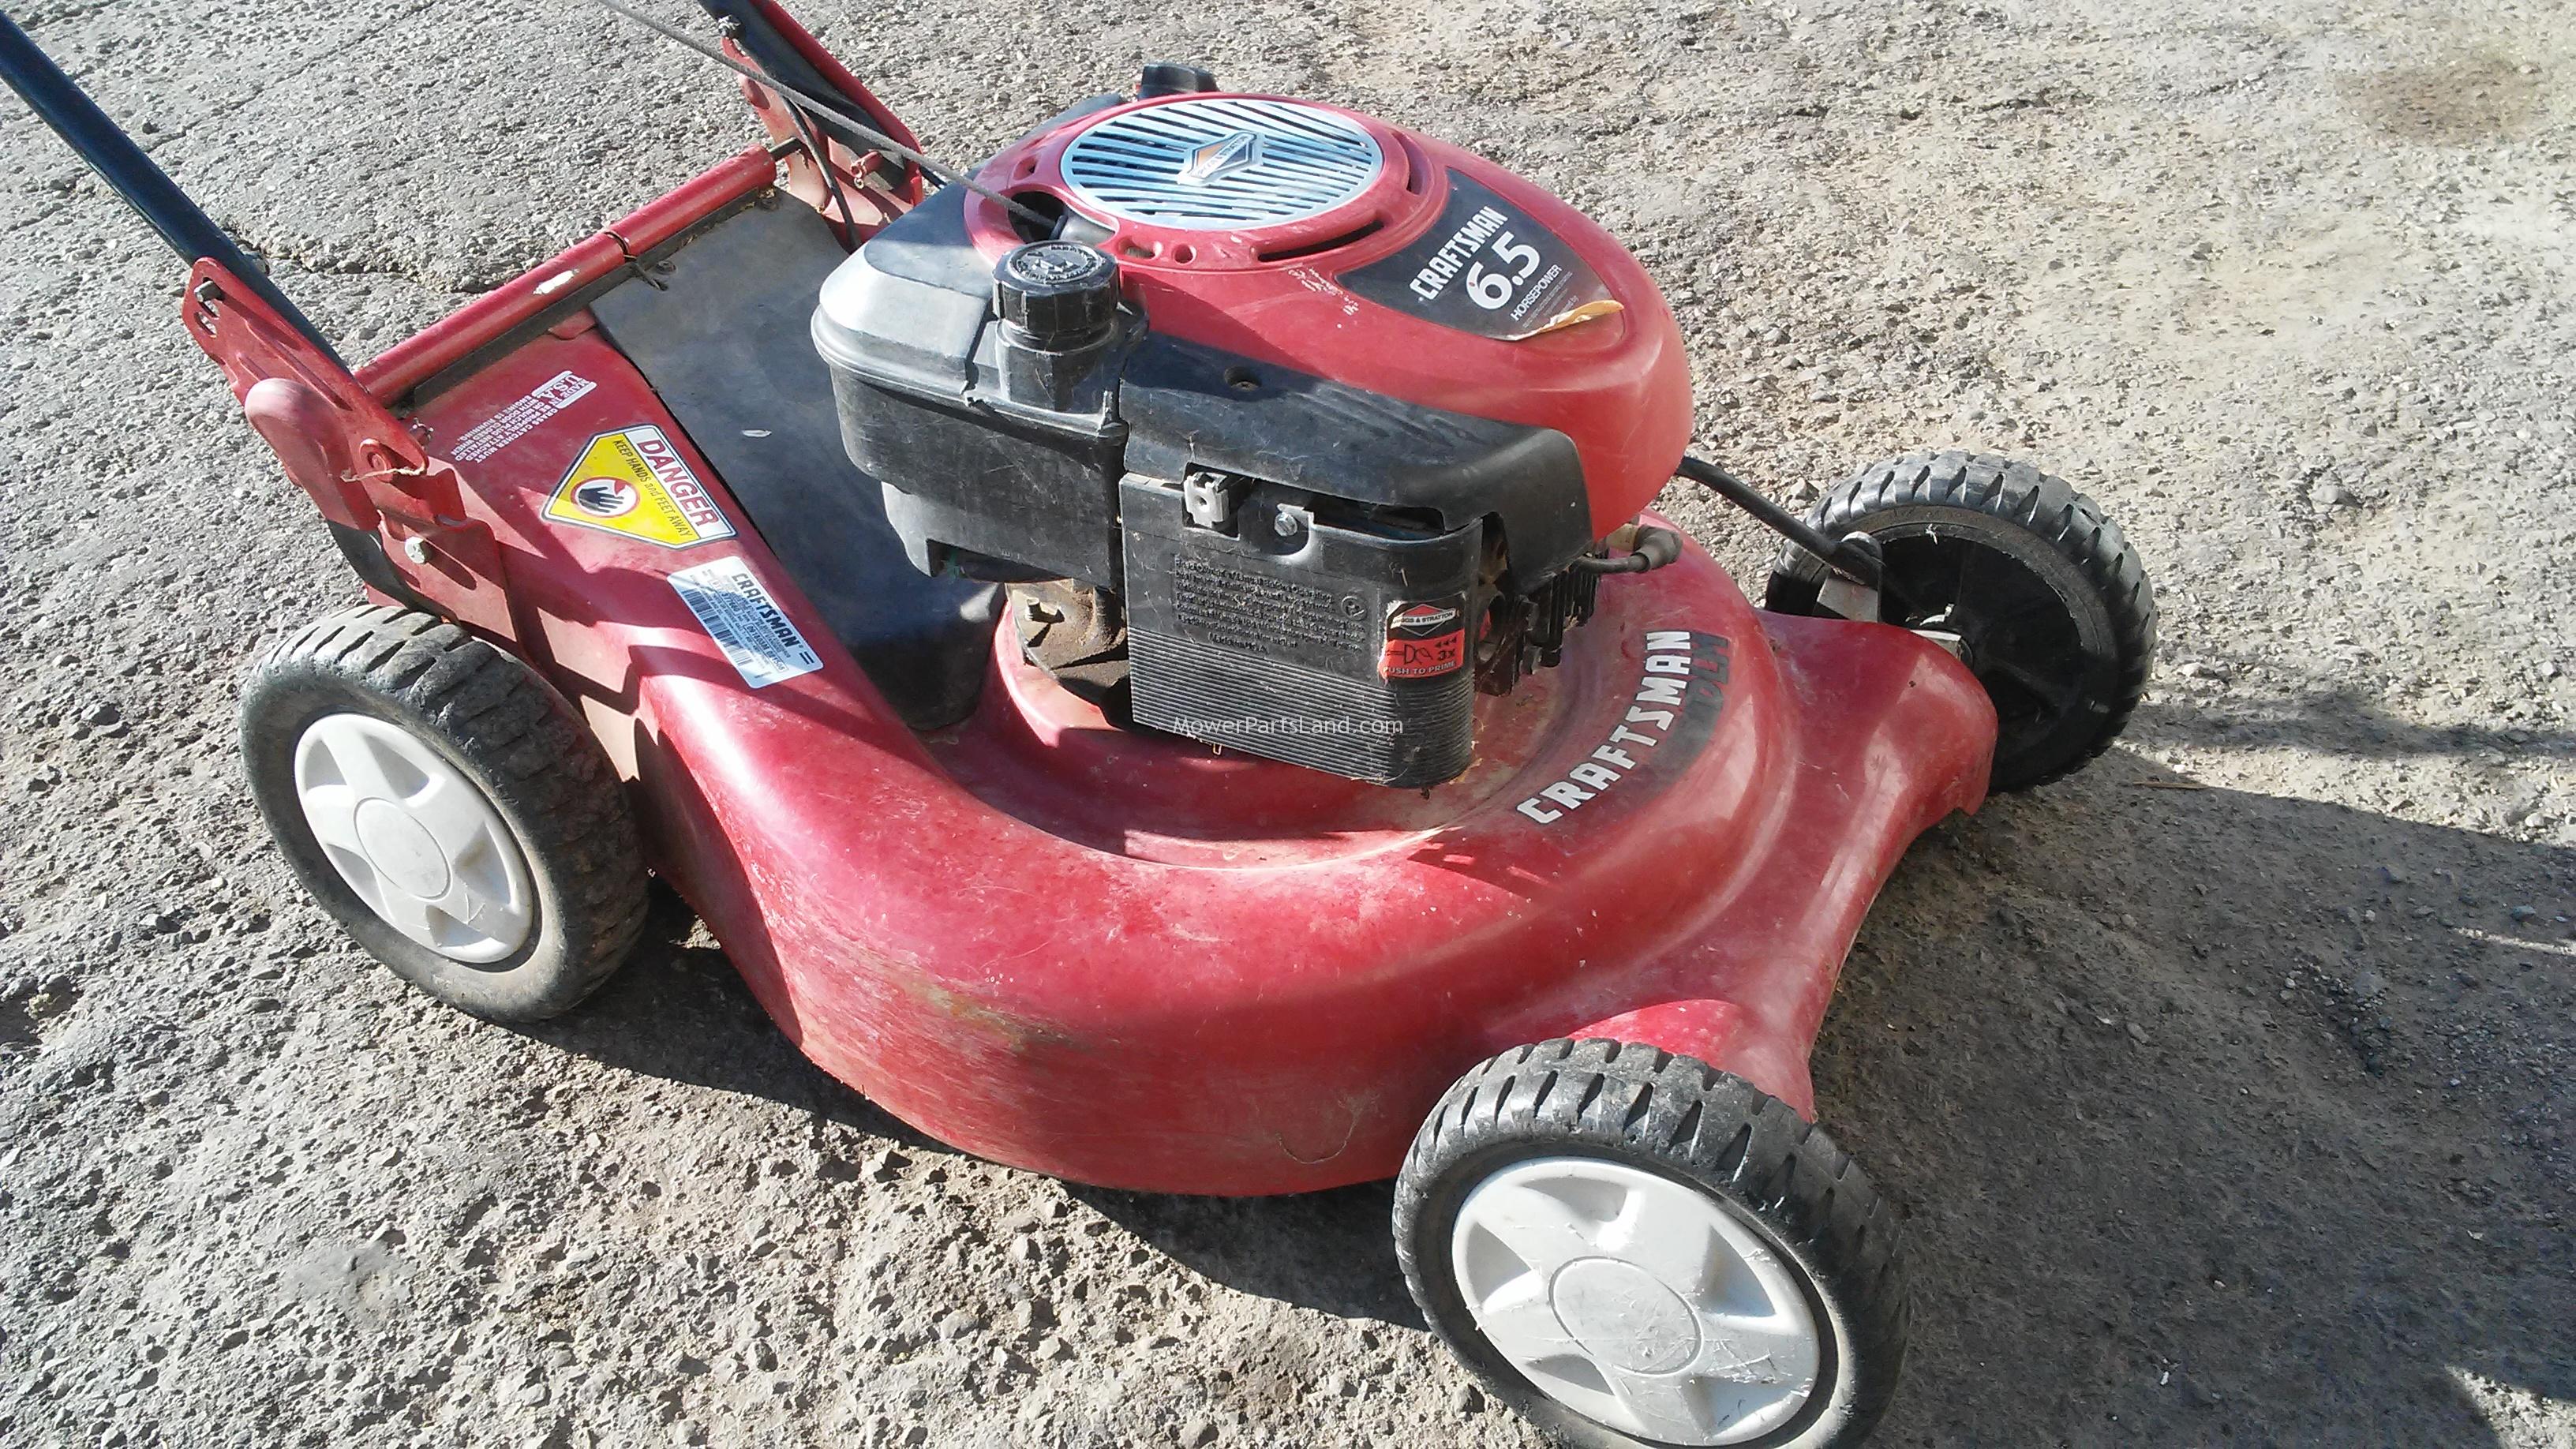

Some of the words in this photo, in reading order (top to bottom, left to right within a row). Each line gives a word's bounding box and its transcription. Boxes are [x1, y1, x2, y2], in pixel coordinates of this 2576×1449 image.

[1410, 206, 1508, 300] CRAFTSMAN
[1466, 230, 1540, 309] 6.5
[1510, 264, 1563, 321] HORSEPOWER
[559, 378, 590, 399] MADE
[501, 395, 533, 414] ENGINE
[517, 398, 539, 412] WITH
[547, 395, 562, 406] IN
[497, 409, 520, 425] DOOR
[503, 411, 541, 436] PROPERLY
[507, 407, 534, 425] MULCH
[530, 408, 558, 425] GRASS
[471, 422, 501, 441] CLOSED
[490, 422, 511, 436] PLUG
[495, 424, 533, 448] CATCHER
[449, 438, 475, 455] WHEN
[453, 434, 493, 459] INSTALLED
[463, 433, 504, 461] ATTACHED
[474, 447, 499, 463] MUST
[612, 438, 634, 459] KEEP
[625, 456, 651, 483] HANDS
[643, 480, 662, 498] and
[653, 496, 675, 514] FEET
[667, 515, 692, 537] AWAY
[637, 439, 719, 526] DANGER
[731, 571, 800, 648] CRAFTSMAN
[1422, 611, 1454, 623] STRATTON
[1428, 661, 1456, 673] PRIME
[1516, 630, 1692, 825] CRAFTSMAN
